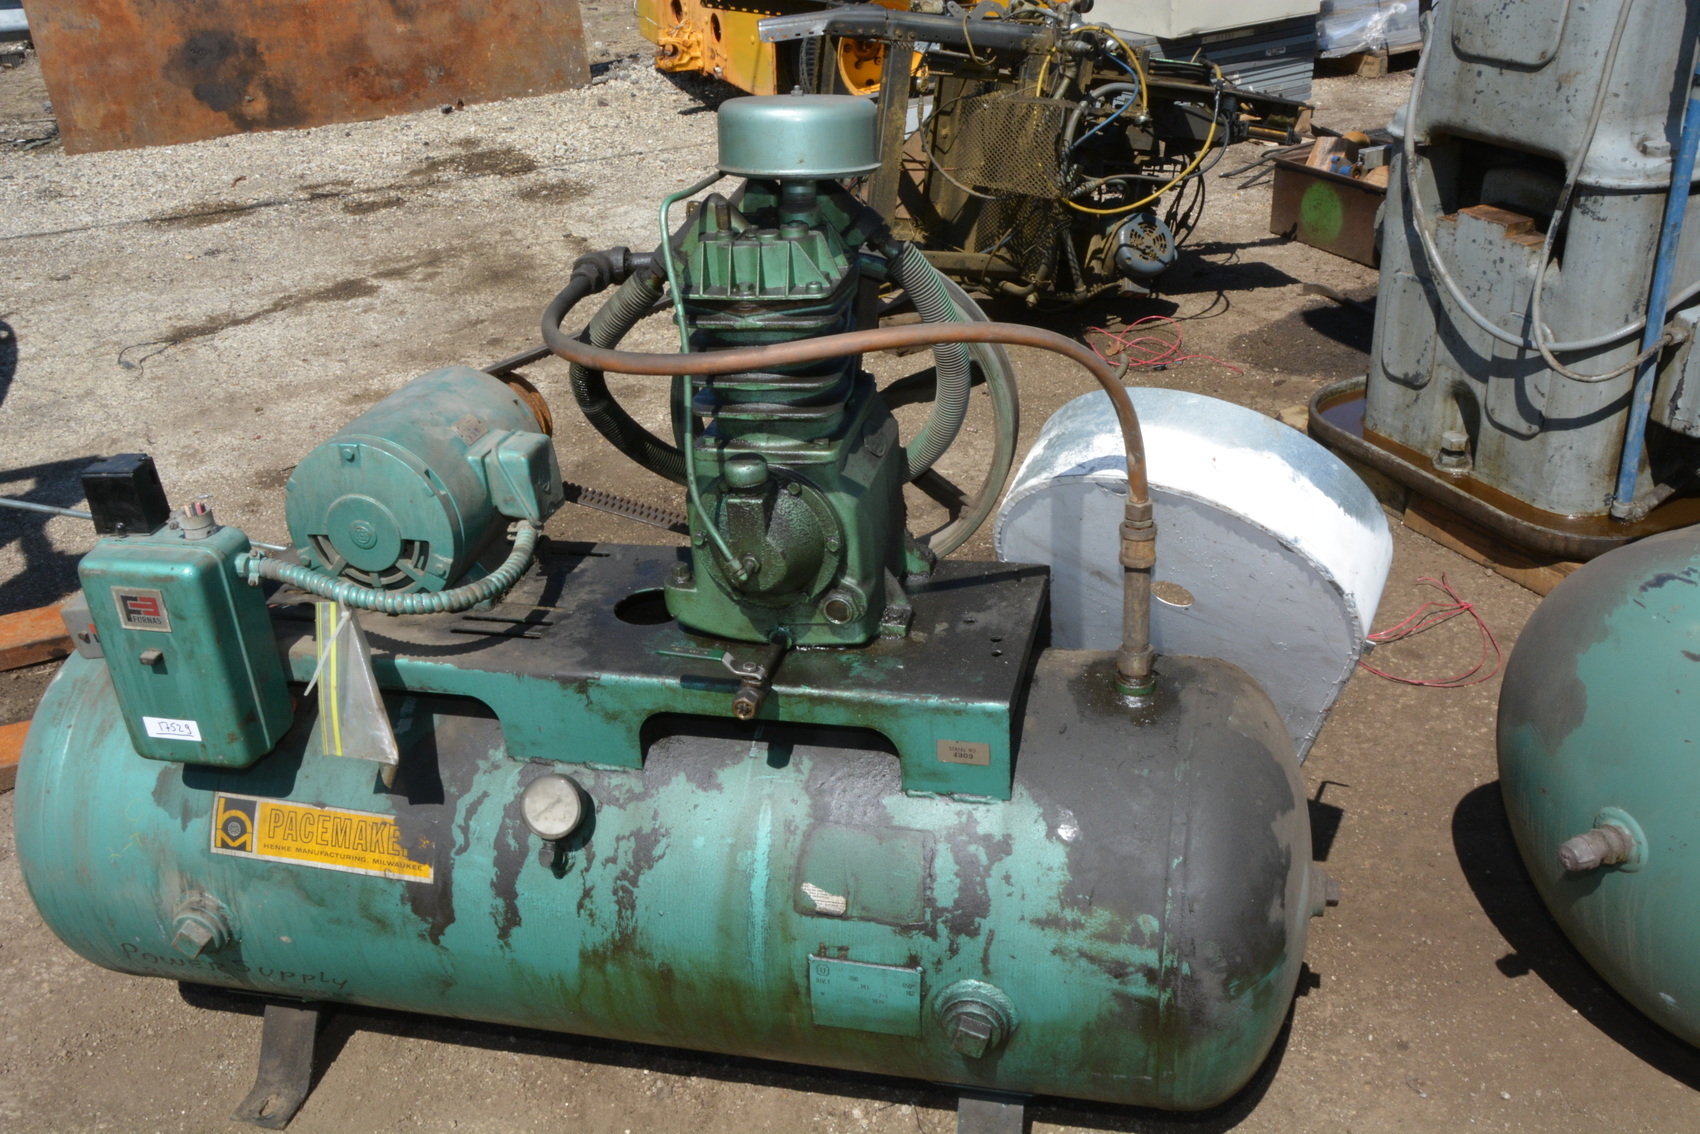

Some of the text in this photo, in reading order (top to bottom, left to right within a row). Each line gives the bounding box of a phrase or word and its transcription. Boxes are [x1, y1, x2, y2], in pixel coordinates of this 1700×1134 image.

[132, 615, 163, 625] FURNAS
[158, 721, 192, 735] 17529
[268, 808, 408, 857] PACEMAKE
[263, 843, 292, 852] HENKE
[372, 858, 423, 872] MILWAUKEE
